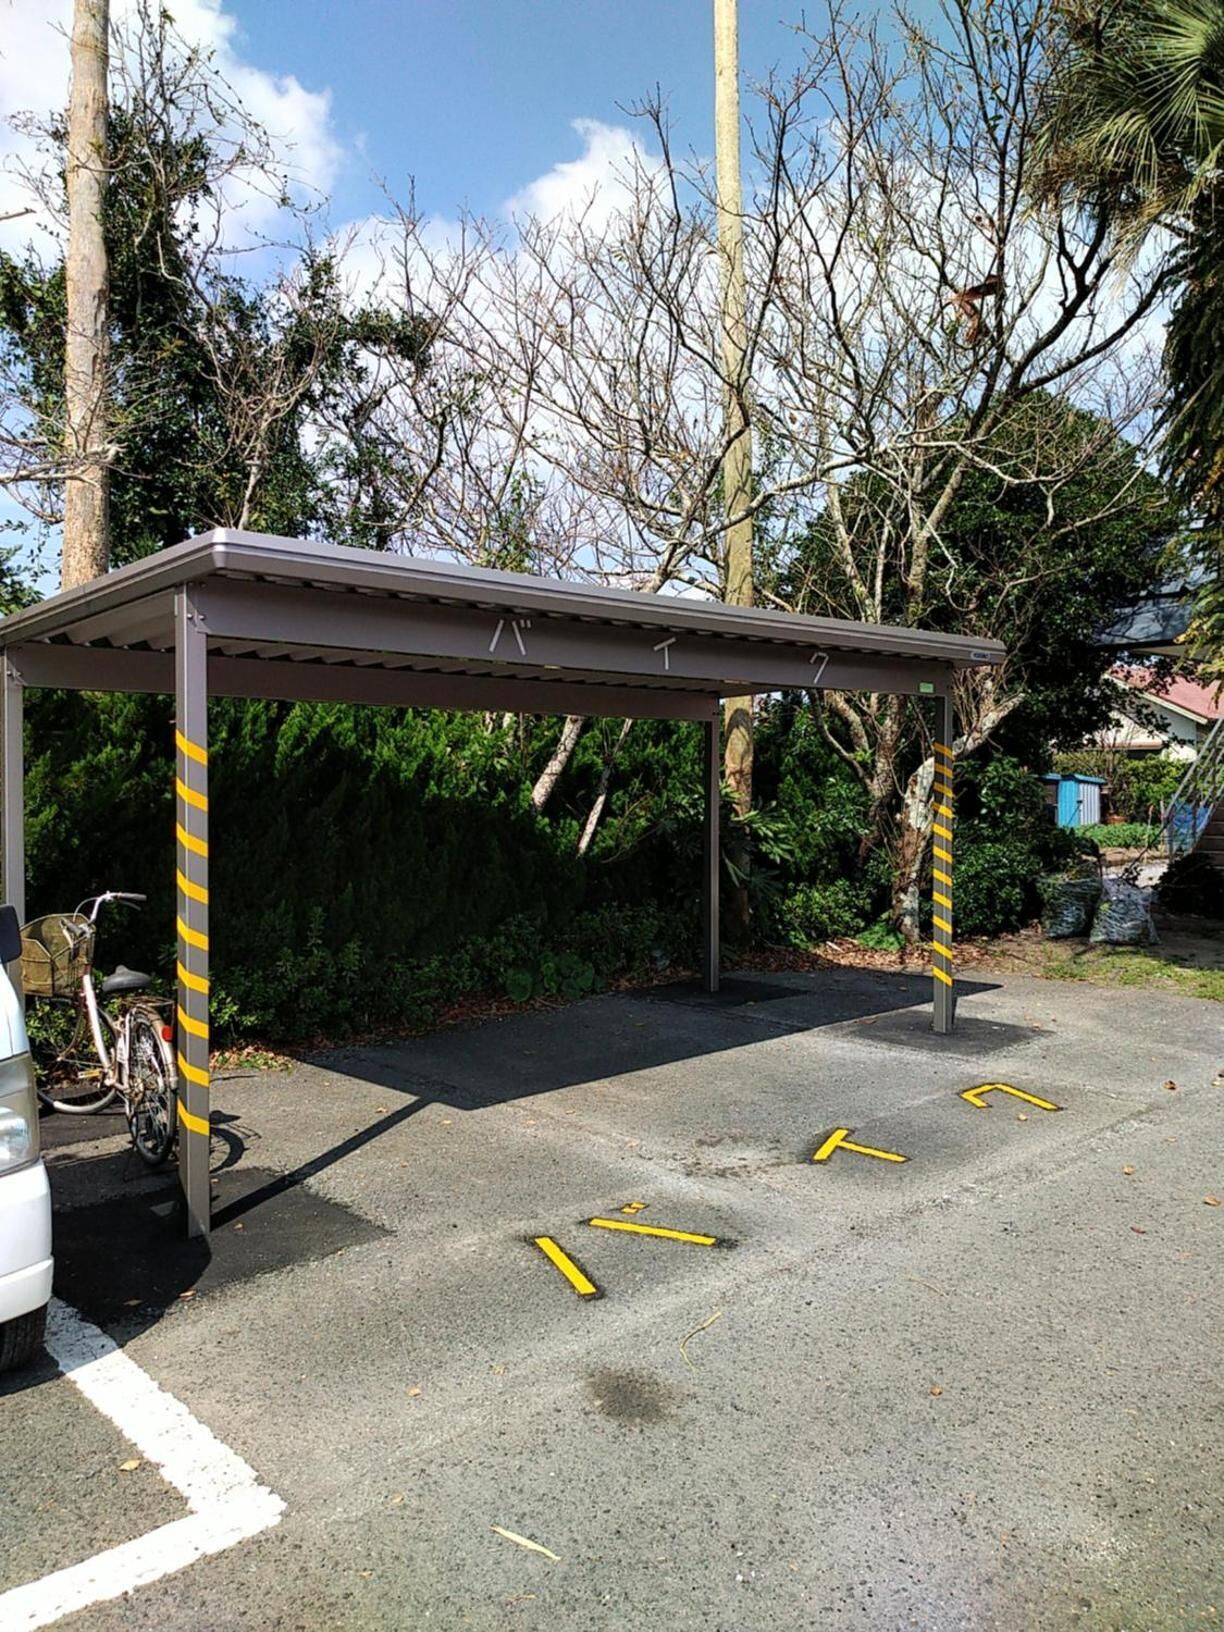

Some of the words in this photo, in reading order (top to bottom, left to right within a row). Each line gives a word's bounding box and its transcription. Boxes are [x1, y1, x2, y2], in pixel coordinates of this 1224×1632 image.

[489, 618, 829, 684] バイク
[535, 1083, 1060, 1296] バイク
